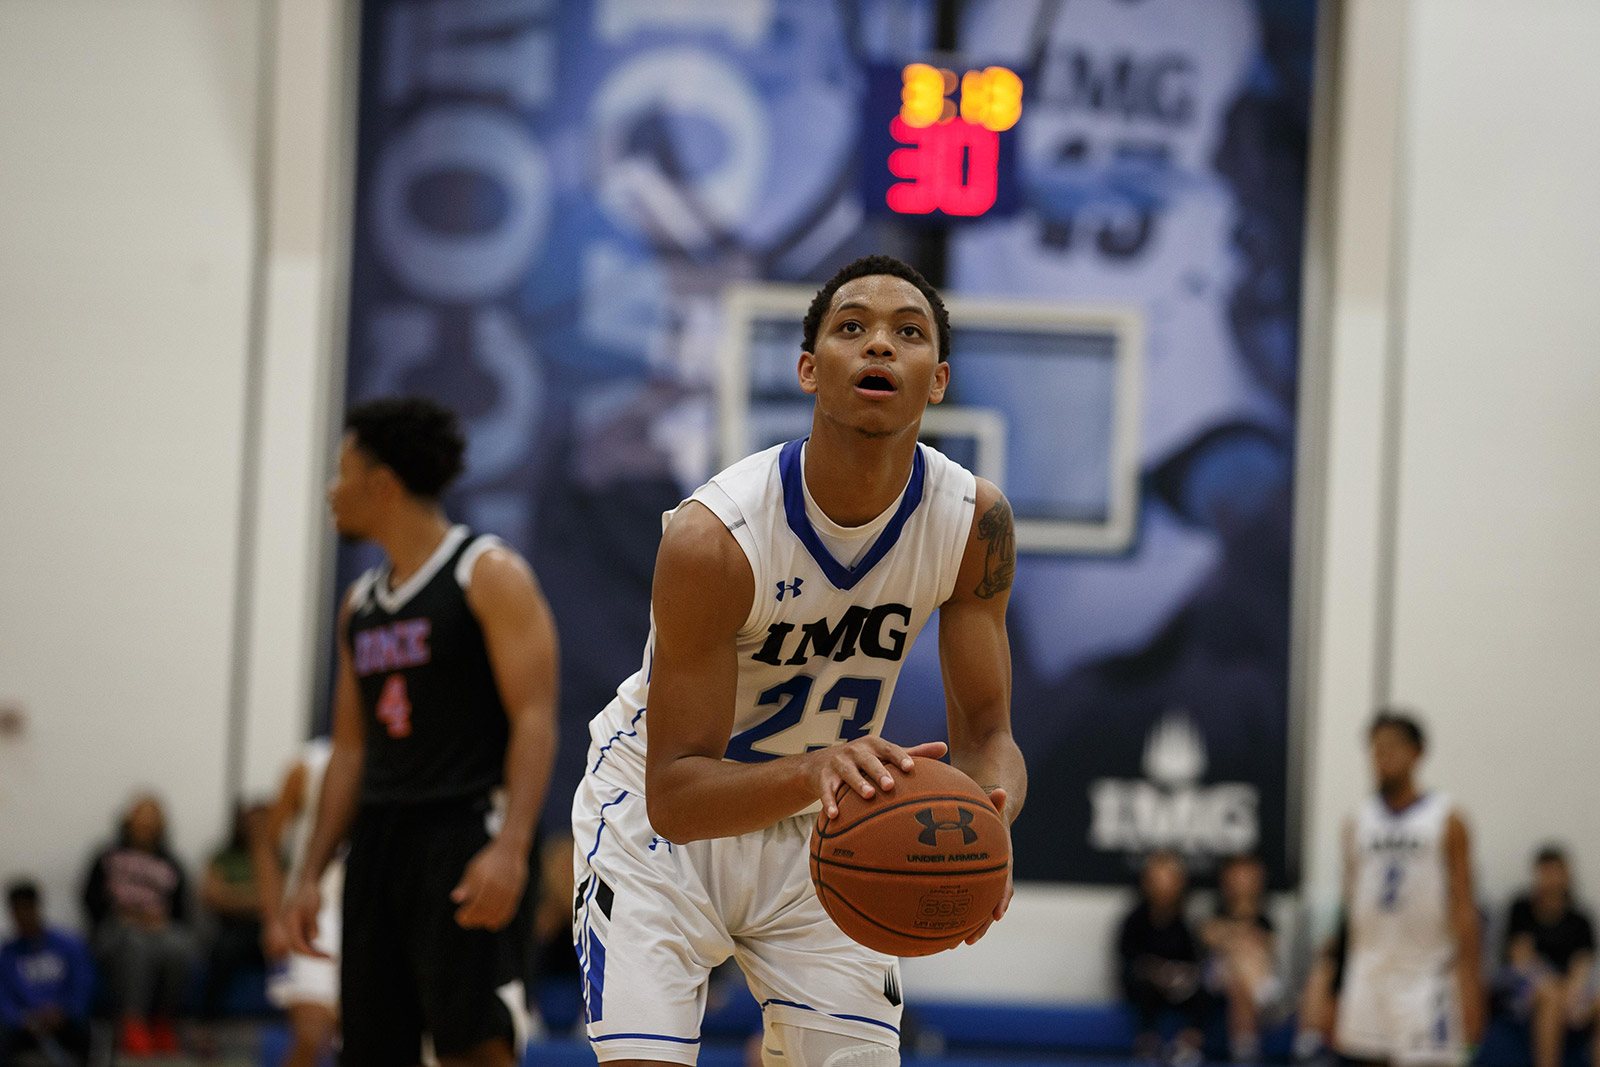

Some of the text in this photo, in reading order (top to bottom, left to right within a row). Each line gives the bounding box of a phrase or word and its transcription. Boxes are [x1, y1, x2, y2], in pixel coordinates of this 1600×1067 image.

[886, 113, 999, 216] 30
[751, 603, 912, 666] IMG
[376, 674, 412, 738] 4
[721, 675, 886, 763] 23
[906, 852, 988, 863] UNDER ARMOUR
[921, 898, 971, 918] 695
